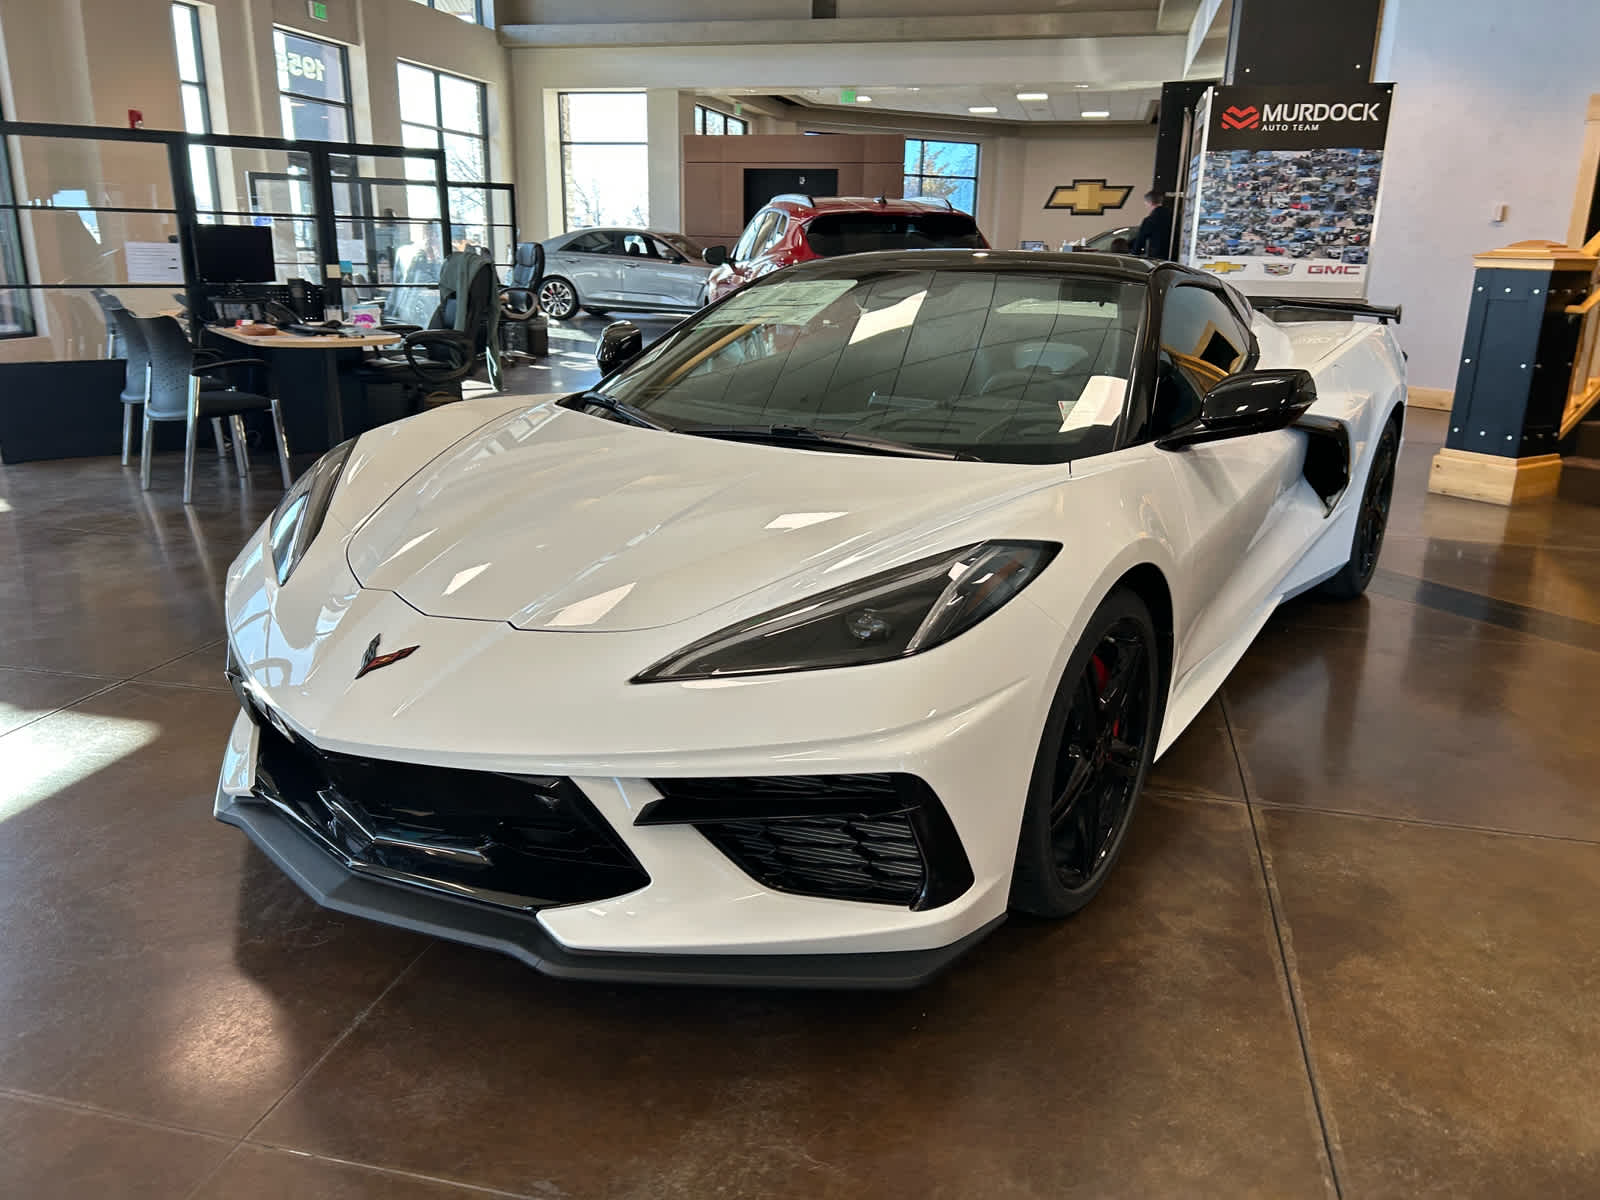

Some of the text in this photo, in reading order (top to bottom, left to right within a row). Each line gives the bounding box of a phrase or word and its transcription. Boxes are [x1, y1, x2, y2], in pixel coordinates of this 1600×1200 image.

[1262, 103, 1380, 122] MURDOCK
[1261, 124, 1288, 132] AUTO
[1307, 265, 1361, 275] GMC
